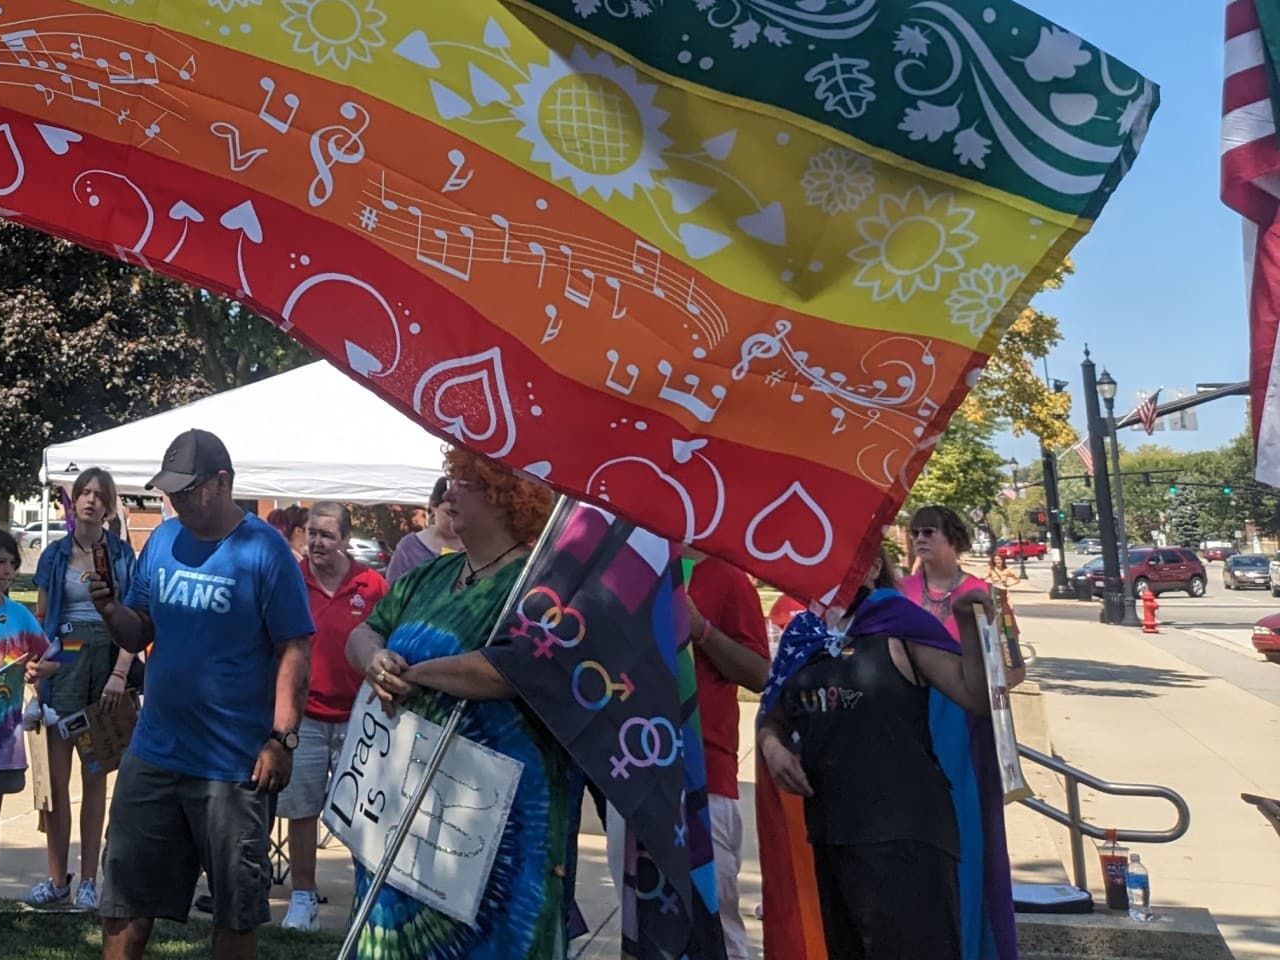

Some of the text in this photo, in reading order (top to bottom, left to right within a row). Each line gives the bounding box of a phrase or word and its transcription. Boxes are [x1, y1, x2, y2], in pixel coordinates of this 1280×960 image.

[158, 567, 236, 614] VANS
[330, 711, 391, 828] Drag
[359, 786, 386, 824] is
